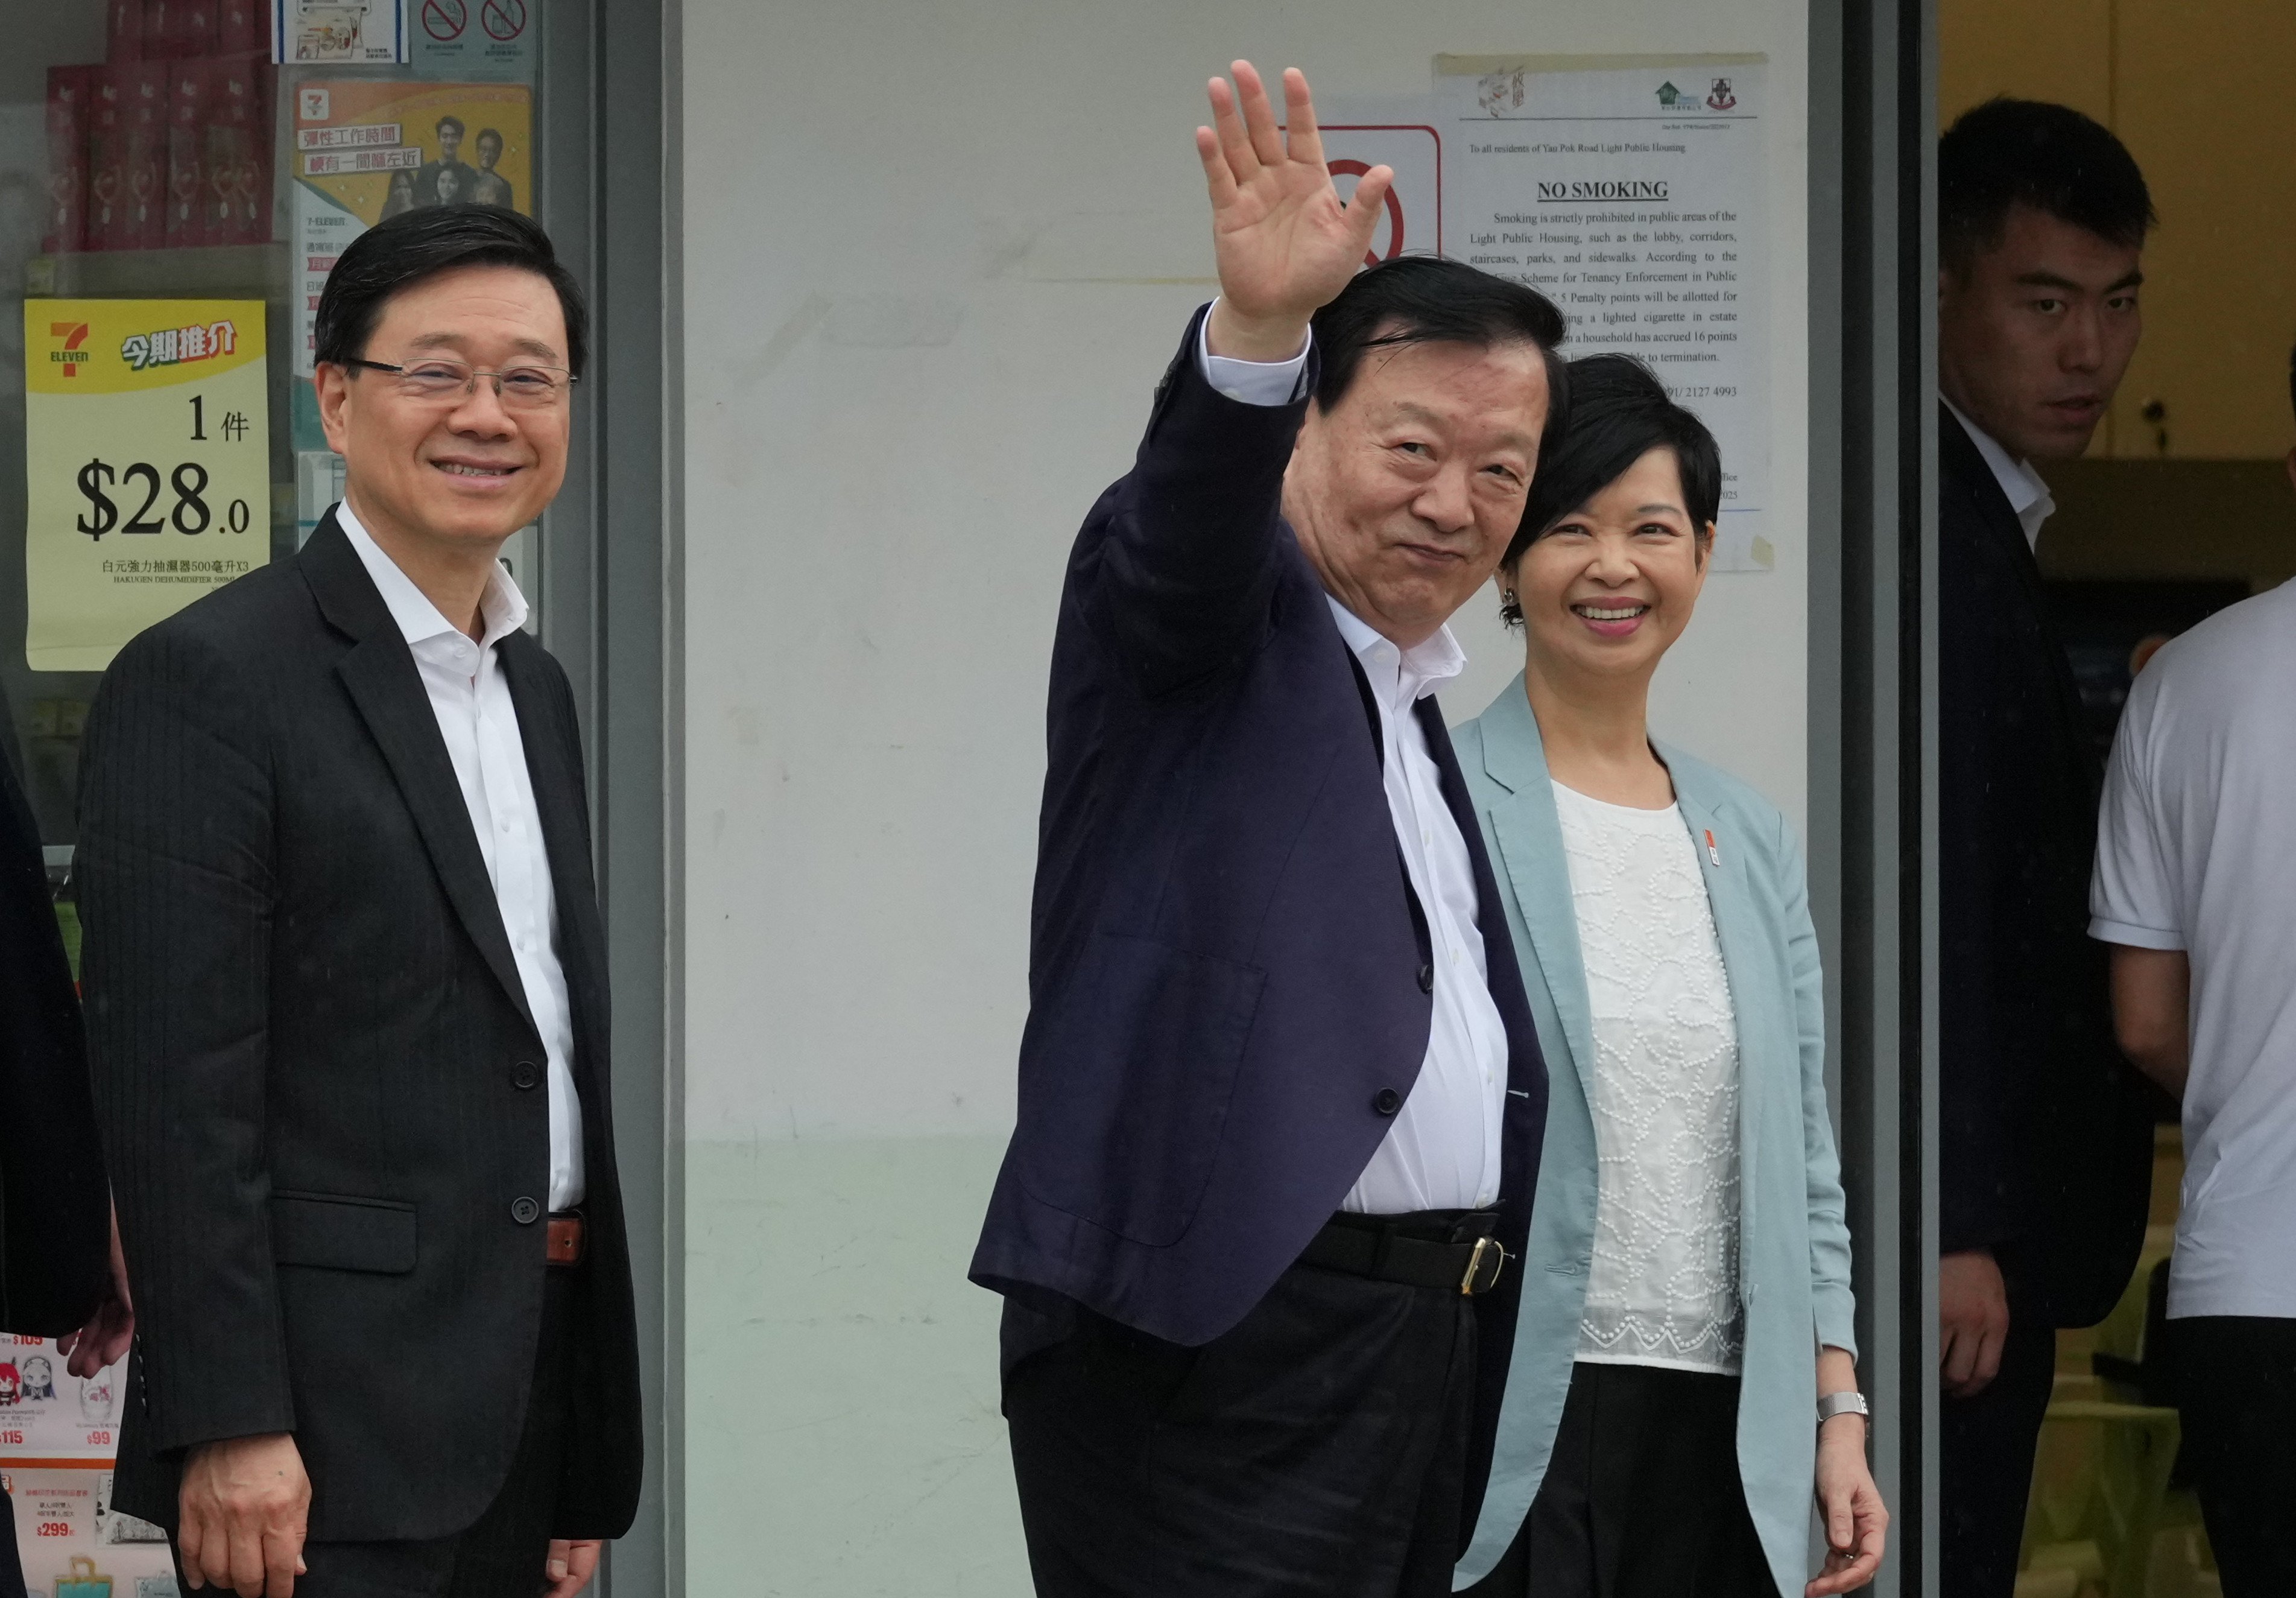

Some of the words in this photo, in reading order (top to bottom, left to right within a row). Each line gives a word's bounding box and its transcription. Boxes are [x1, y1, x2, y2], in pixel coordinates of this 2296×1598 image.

[1470, 145, 1479, 153] To
[1482, 145, 1491, 153] all
[1494, 145, 1529, 153] residents
[1532, 144, 1540, 153] of
[1578, 144, 1598, 153] Road
[1601, 144, 1622, 154] Light
[1625, 144, 1649, 152] Public
[1652, 144, 1686, 154] Housing
[1537, 182, 1566, 198] NO
[1572, 181, 1669, 198] SMOKING
[1494, 213, 1537, 226] Smoking
[1540, 214, 1548, 224] is
[1551, 213, 1583, 226] strictly
[1586, 212, 1635, 226] prohibited
[1637, 212, 1646, 223] in
[1649, 212, 1679, 225] public
[1709, 211, 1720, 222] of
[1721, 211, 1736, 222] the
[1470, 233, 1496, 246] Light
[1502, 233, 1532, 244] Public
[1540, 233, 1583, 246] Housing,
[1589, 232, 1610, 243] such
[1633, 232, 1648, 243] the
[1654, 232, 1683, 244] lobby,
[1690, 232, 1737, 243] corridors,
[1470, 253, 1519, 265] staircases,
[1527, 253, 1556, 265] parks,
[1564, 253, 1581, 264] and
[1646, 251, 1697, 264] According
[1705, 253, 1715, 262] to
[1722, 251, 1737, 262] the
[1521, 273, 1559, 284] Scheme
[1563, 273, 1577, 284] for
[1581, 273, 1621, 285] Tenancy
[1626, 271, 1687, 283] Enforcement
[1693, 271, 1701, 282] in
[1706, 271, 1737, 282] Public
[1561, 293, 1566, 303] 5
[1570, 293, 1607, 305] Penalty
[1610, 293, 1640, 305] points
[1645, 292, 1663, 302] will
[1667, 292, 1678, 302] be
[1683, 291, 1719, 302] allotted
[1723, 291, 1738, 302] for
[1603, 312, 1636, 326] lighted
[1644, 312, 1685, 325] cigarette
[1694, 312, 1702, 322] in
[1710, 313, 1738, 322] estate
[1583, 332, 1632, 343] household
[1634, 332, 1651, 343] has
[1653, 332, 1690, 343] accrued
[1695, 332, 1706, 342] 16
[1708, 332, 1738, 344] points
[121, 320, 239, 371] 今期推介
[1648, 354, 1658, 362] to
[1660, 352, 1720, 362] termination.
[1686, 387, 1710, 398] 2127
[1713, 387, 1737, 397] 4993
[189, 395, 207, 440] 1
[221, 411, 249, 442] 件
[77, 458, 249, 541] $28.0
[87, 1430, 110, 1445] $99
